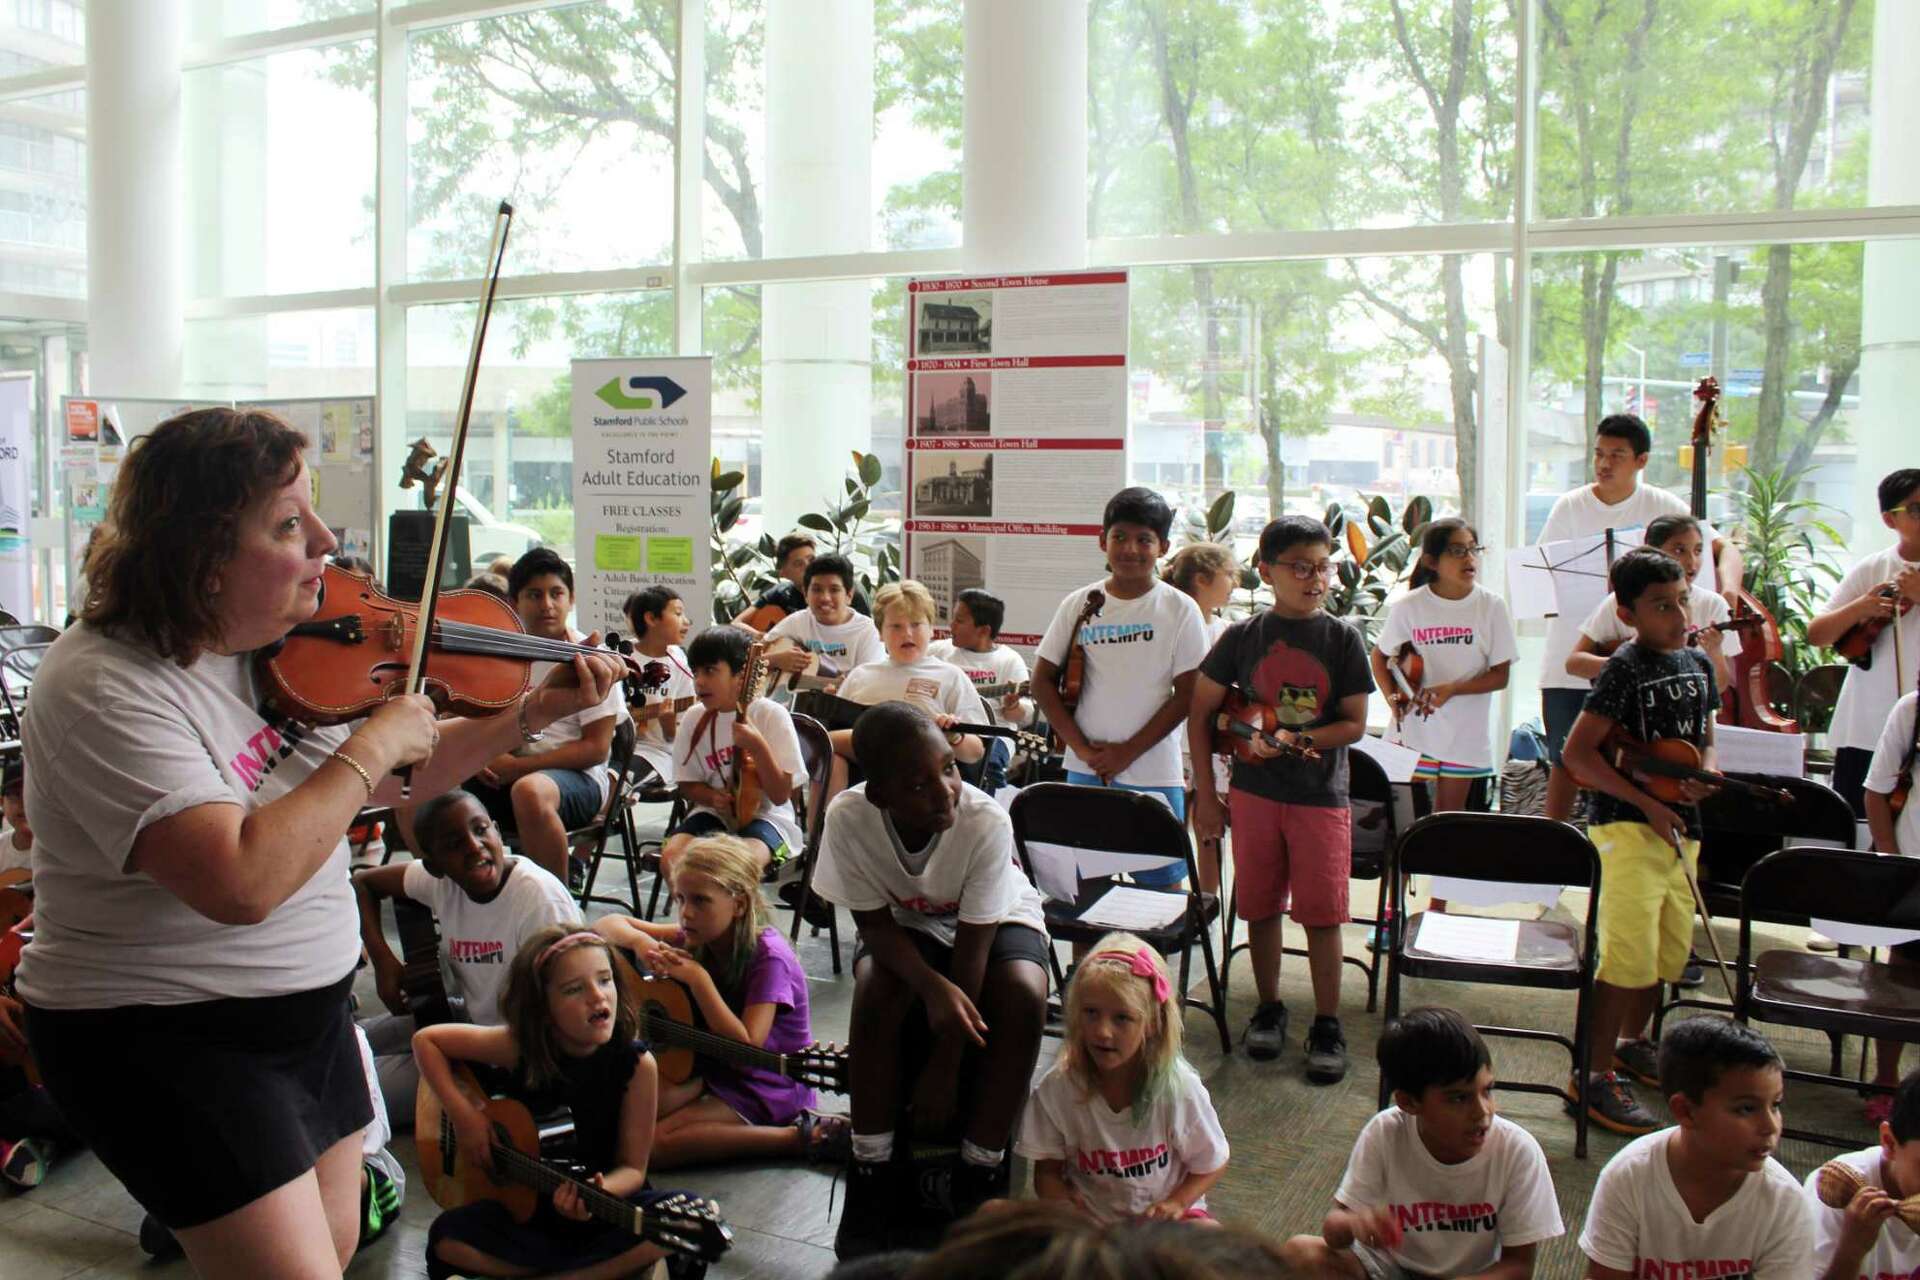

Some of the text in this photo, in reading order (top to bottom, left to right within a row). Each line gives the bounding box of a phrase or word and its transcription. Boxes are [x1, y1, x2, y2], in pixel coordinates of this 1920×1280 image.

[971, 279, 999, 289] Second
[1001, 278, 1022, 287] Town
[1024, 277, 1049, 286] House
[970, 359, 988, 368] First
[991, 358, 1010, 367] Town
[1012, 356, 1029, 367] Hall
[593, 415, 688, 427] Stamford Public Schools
[968, 439, 996, 449] Second
[999, 439, 1019, 449] Town
[1021, 439, 1038, 449] Hall
[607, 448, 675, 464] Stamford
[582, 470, 700, 487] Adult Education
[602, 504, 682, 517] FREE CLASSES
[968, 523, 1006, 535] Municipal
[1007, 523, 1031, 533] Office
[1032, 524, 1068, 536] Building
[603, 573, 628, 584] Adult
[629, 574, 650, 584] Basic
[1412, 625, 1474, 645] INTEMPO
[1646, 680, 1708, 708] JUST
[448, 937, 503, 964] INTEMPO
[1388, 1201, 1498, 1233] INTEMPO
